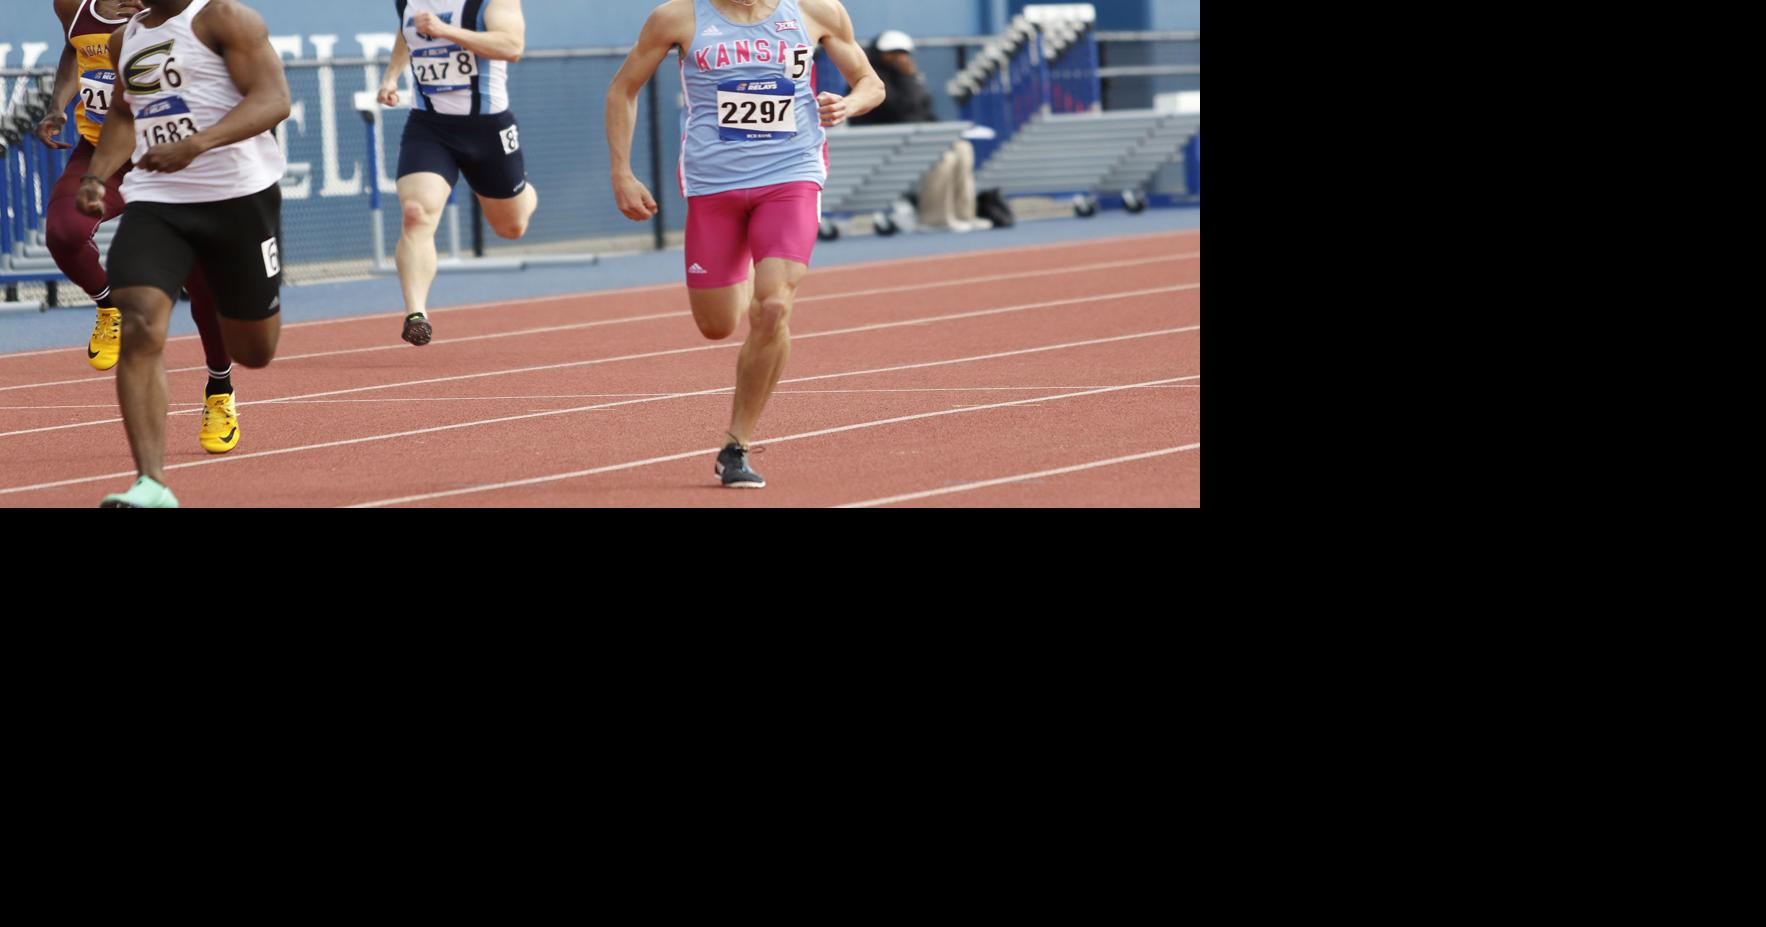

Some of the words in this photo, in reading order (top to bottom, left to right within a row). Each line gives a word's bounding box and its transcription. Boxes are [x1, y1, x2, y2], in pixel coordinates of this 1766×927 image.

[456, 52, 472, 75] 8
[695, 39, 808, 72] KANSA
[792, 49, 808, 79] 5
[163, 56, 182, 88] 6
[82, 88, 113, 111] 21
[721, 99, 792, 124] 2297
